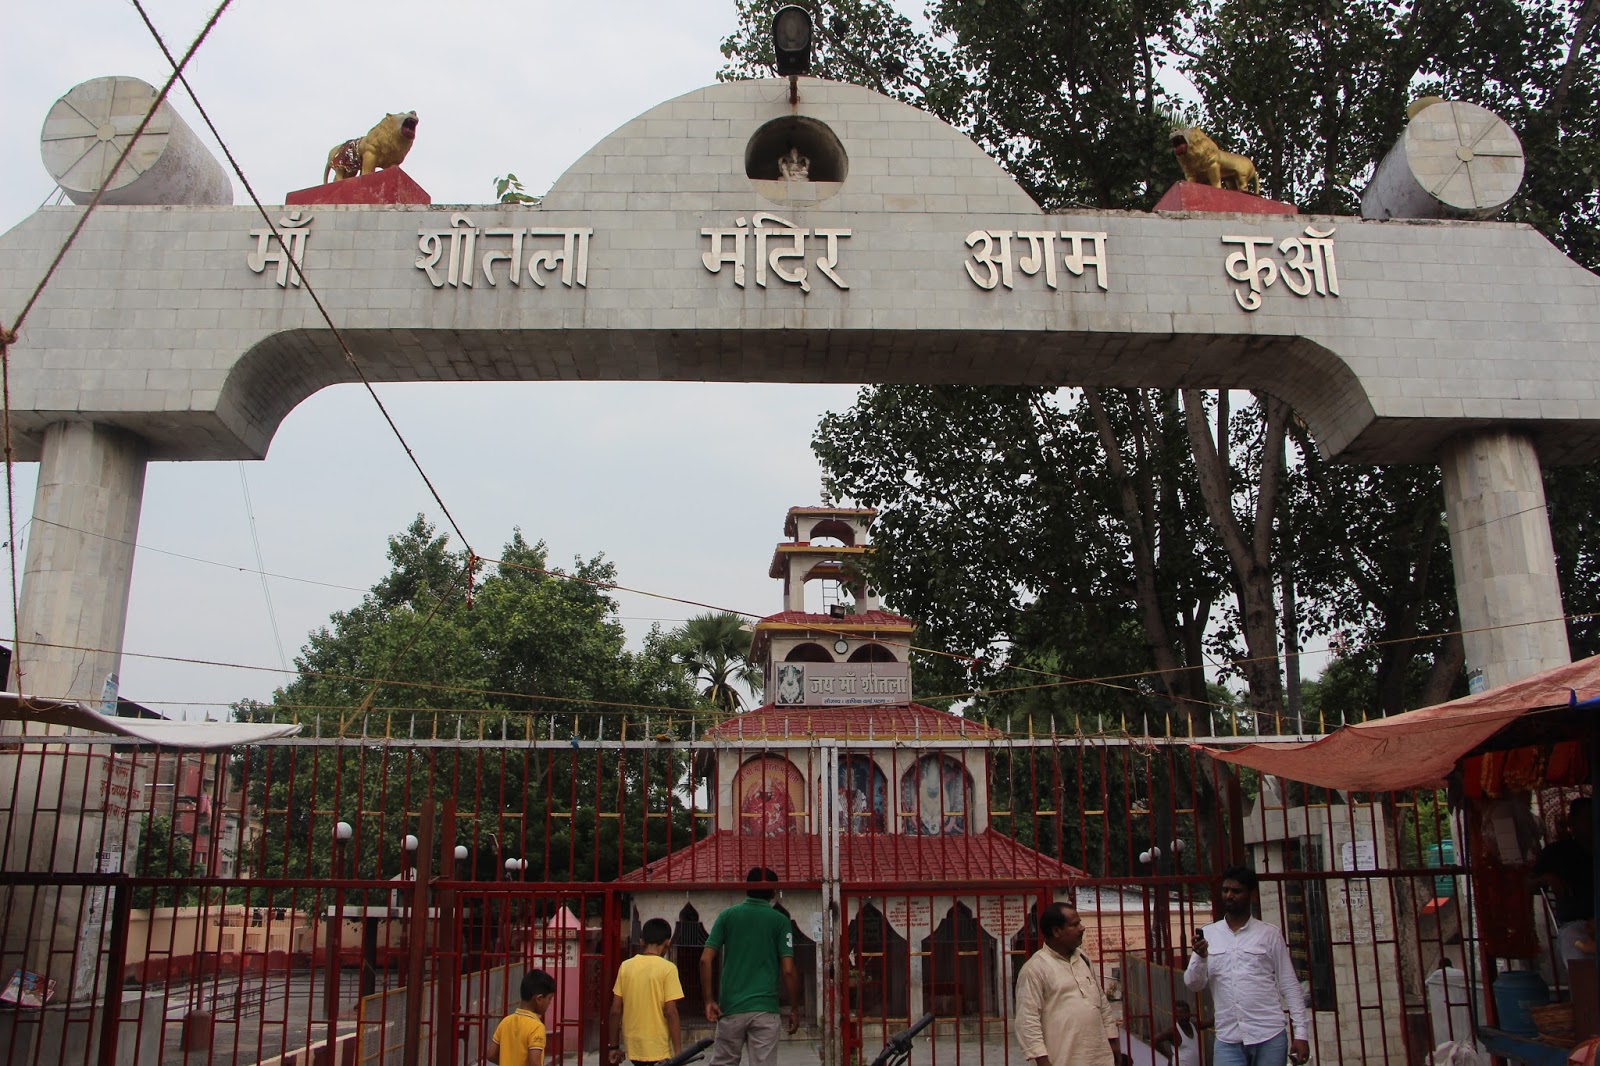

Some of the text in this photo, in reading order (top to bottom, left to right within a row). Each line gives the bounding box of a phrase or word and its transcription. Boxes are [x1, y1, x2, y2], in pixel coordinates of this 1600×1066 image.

[247, 211, 314, 288] माँ
[415, 212, 594, 288] शीतला
[701, 212, 852, 293] मंदिर
[964, 230, 1107, 291] अगम
[809, 676, 836, 694] जय
[861, 672, 907, 694] शीतला
[786, 932, 793, 948] 3
